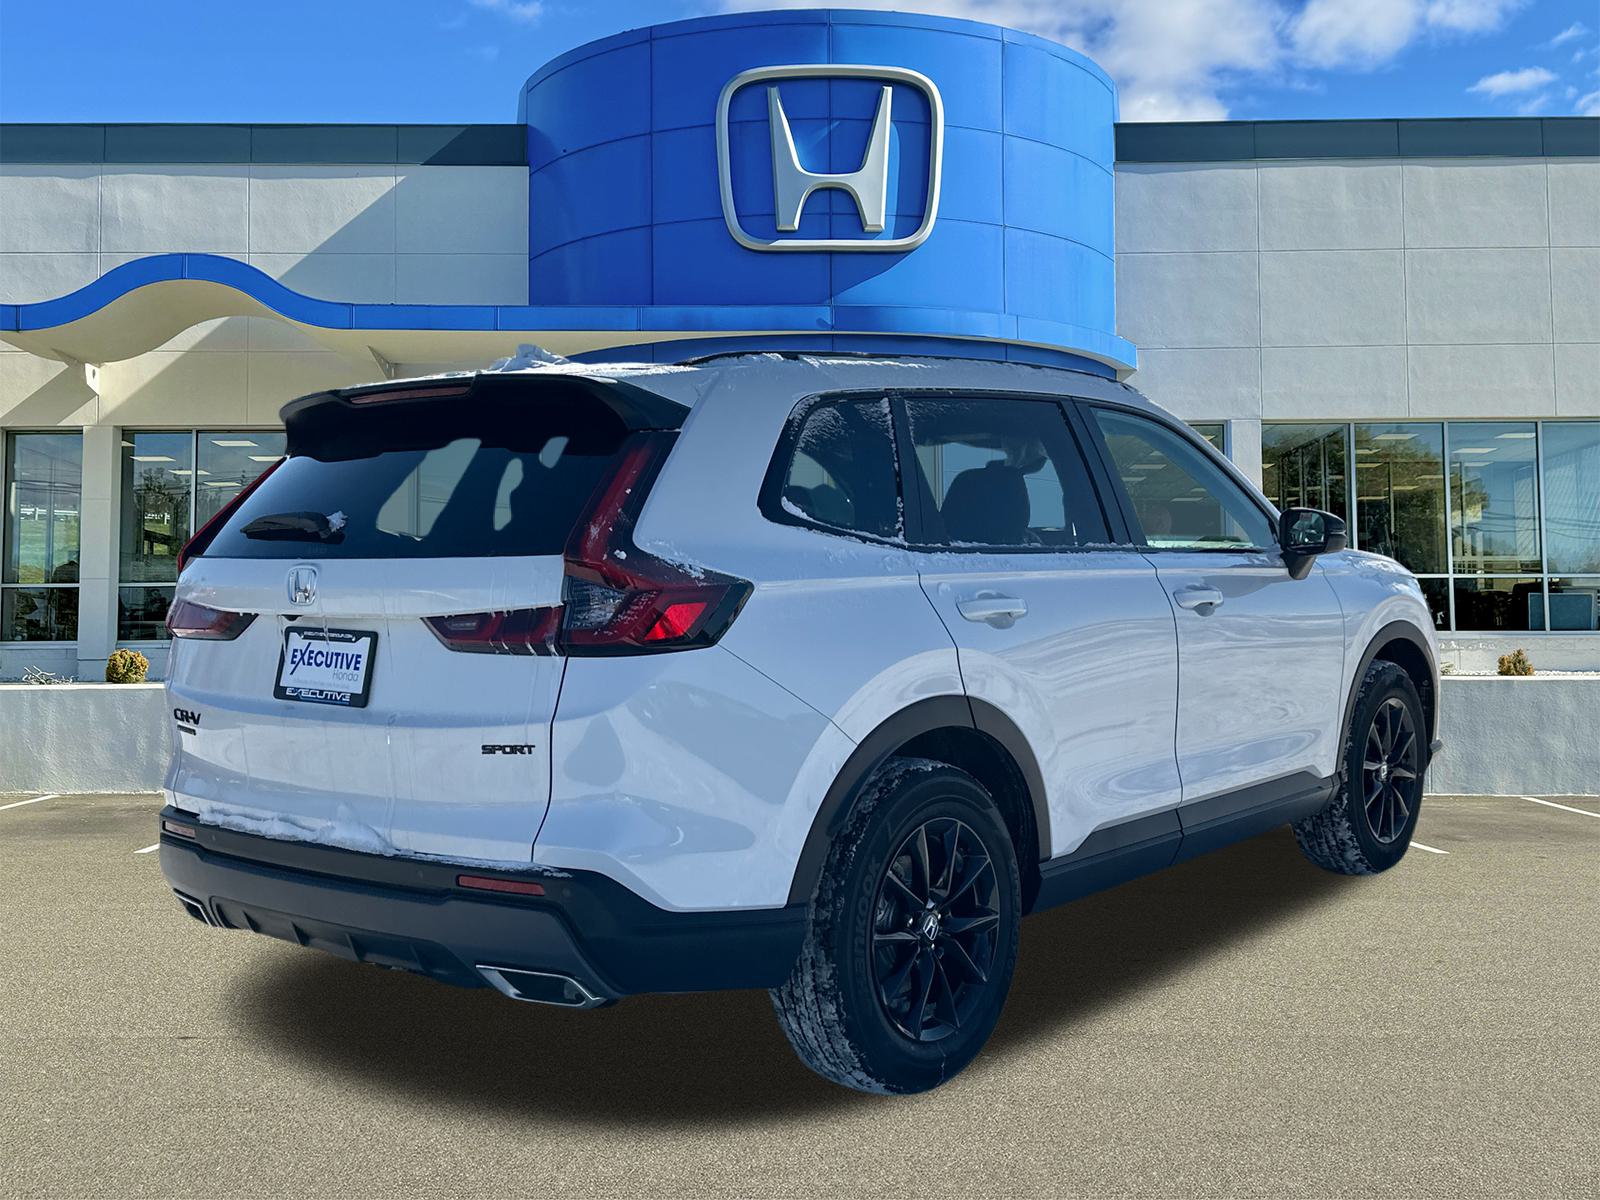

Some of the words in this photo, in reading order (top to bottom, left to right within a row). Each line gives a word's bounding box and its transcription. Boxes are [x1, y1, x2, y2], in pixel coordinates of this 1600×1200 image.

[290, 642, 362, 675] EXECUTIVE
[332, 670, 359, 682] Honda
[285, 688, 351, 702] EXECUTIVE
[174, 708, 201, 725] CR-V
[481, 744, 536, 755] SPORT
